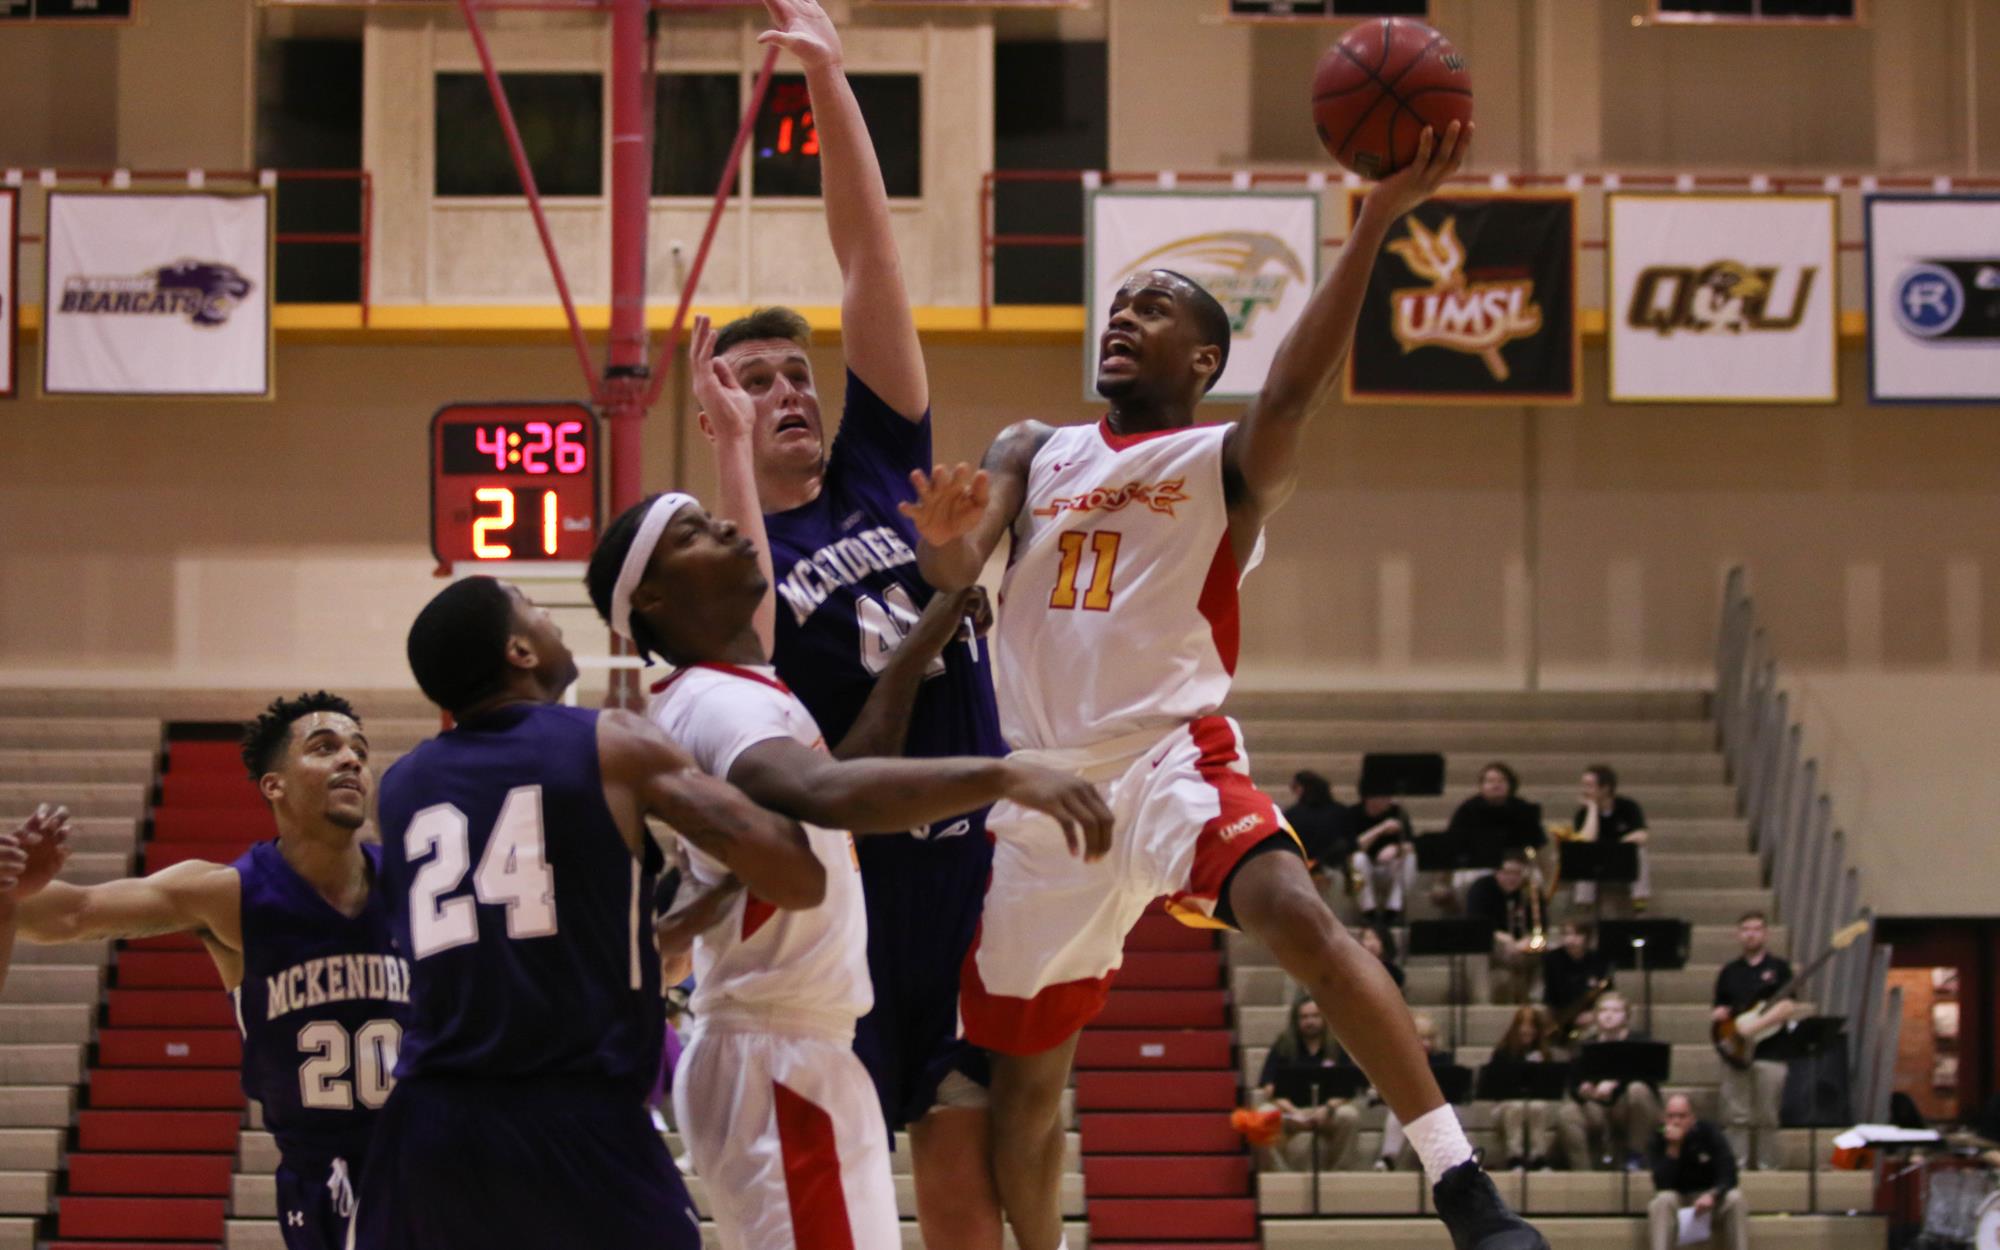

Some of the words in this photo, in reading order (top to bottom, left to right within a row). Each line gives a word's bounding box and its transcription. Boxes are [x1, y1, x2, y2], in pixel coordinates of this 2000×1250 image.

[60, 290, 200, 314] BEARCATS
[1398, 285, 1540, 346] UMSL
[476, 422, 586, 474] 4:26
[473, 487, 558, 559] 21
[1049, 529, 1122, 612] 11
[403, 784, 558, 961] 24
[297, 1018, 403, 1110] 20
